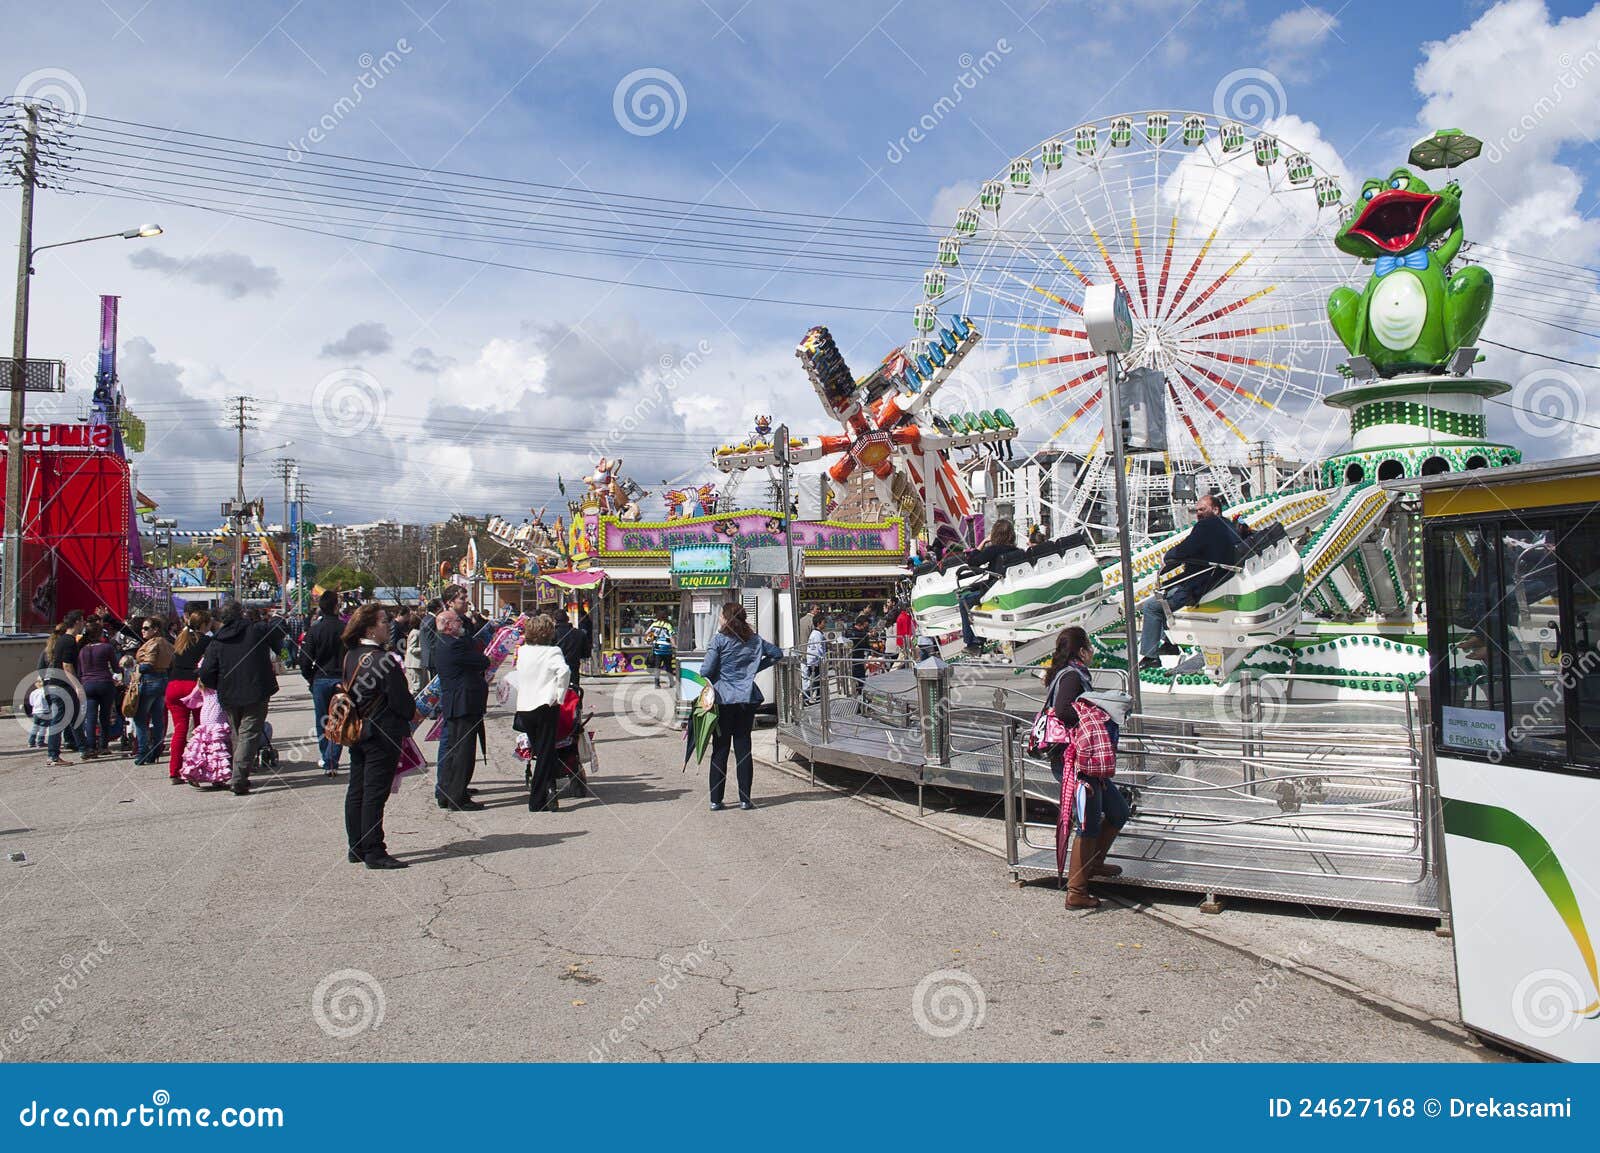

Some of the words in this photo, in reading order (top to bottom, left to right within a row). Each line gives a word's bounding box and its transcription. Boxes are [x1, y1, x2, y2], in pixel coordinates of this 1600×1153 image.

[680, 575, 728, 587] TAQUILLA
[1448, 718, 1469, 728] SUPER
[1471, 721, 1496, 730] ABONO
[1455, 735, 1483, 746] FICHAS
